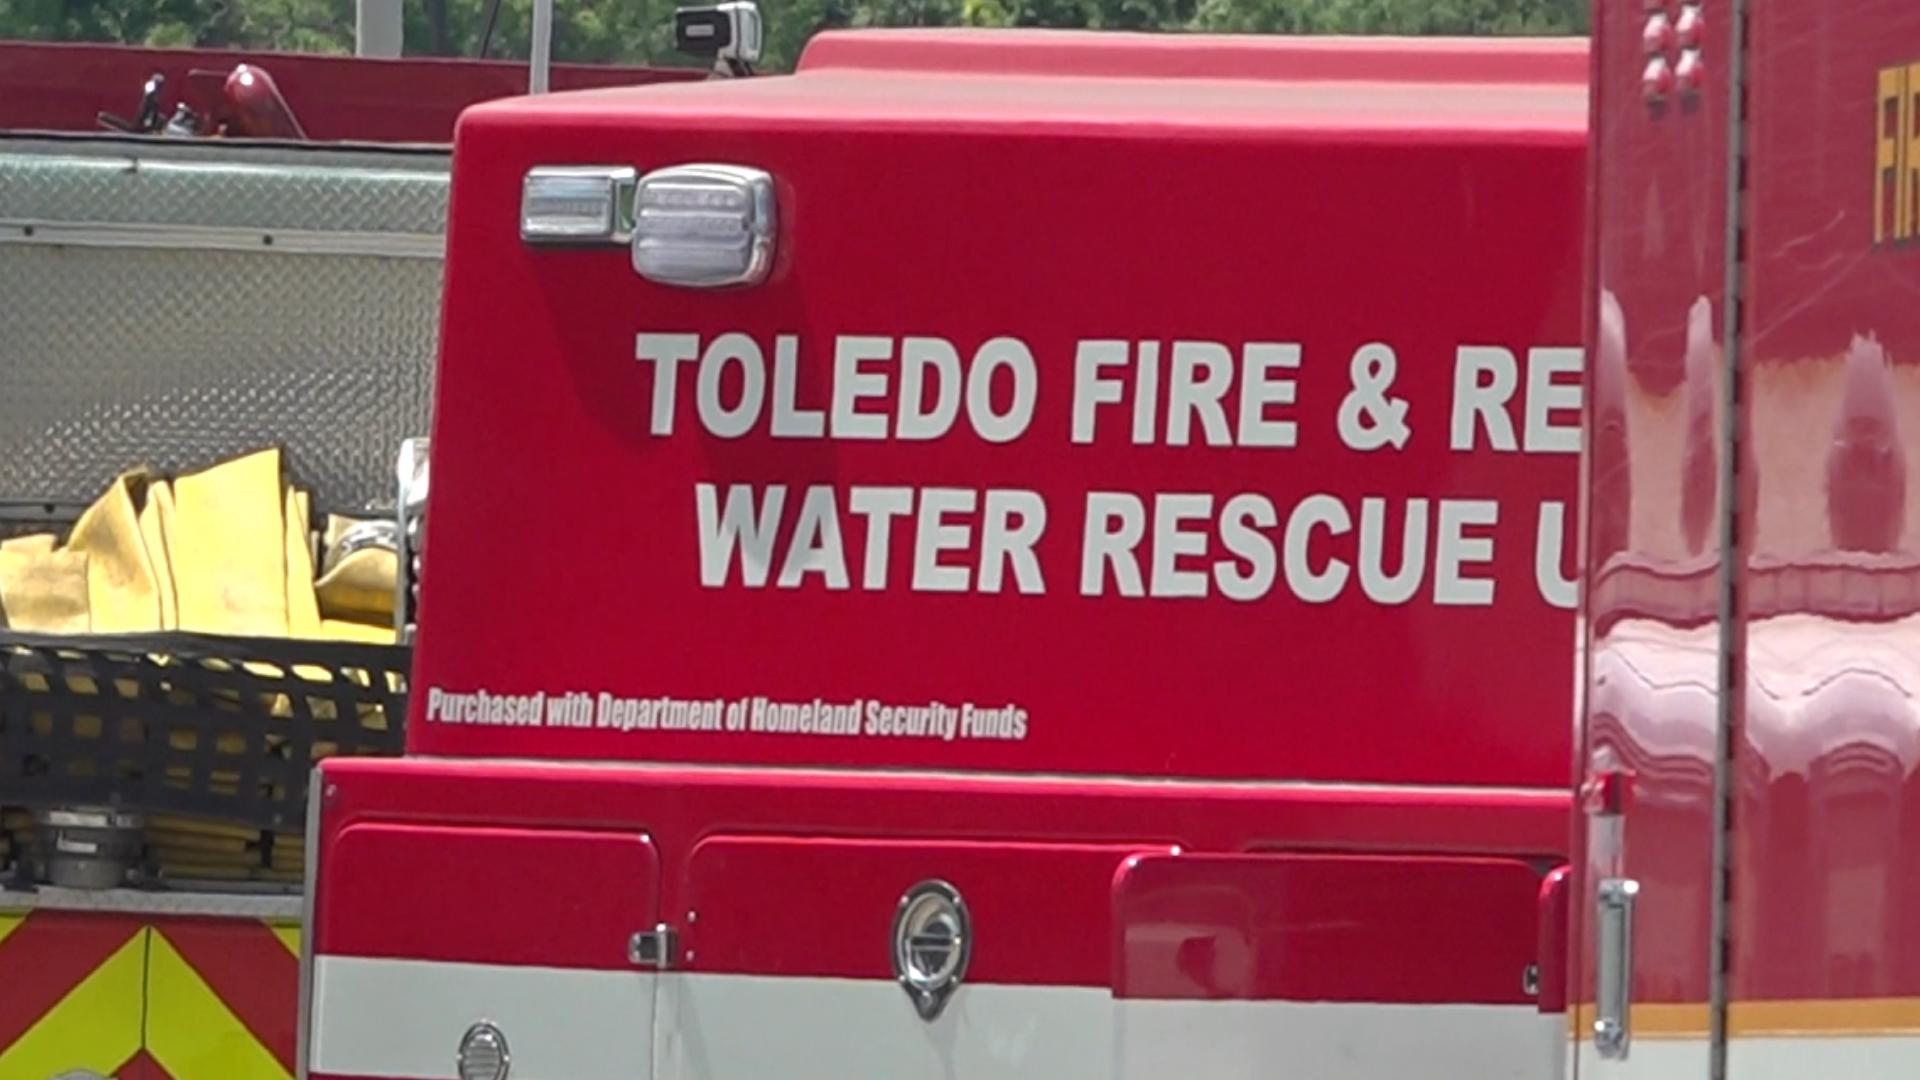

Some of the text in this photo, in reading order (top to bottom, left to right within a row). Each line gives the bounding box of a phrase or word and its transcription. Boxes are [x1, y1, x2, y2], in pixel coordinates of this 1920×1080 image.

[637, 334, 1586, 453] TOLEDO FIRE & RE
[696, 483, 1046, 596] WATER
[1081, 491, 1498, 605] RESCUE
[427, 687, 1027, 741] Purchased with Department of Homeland Security Funds
